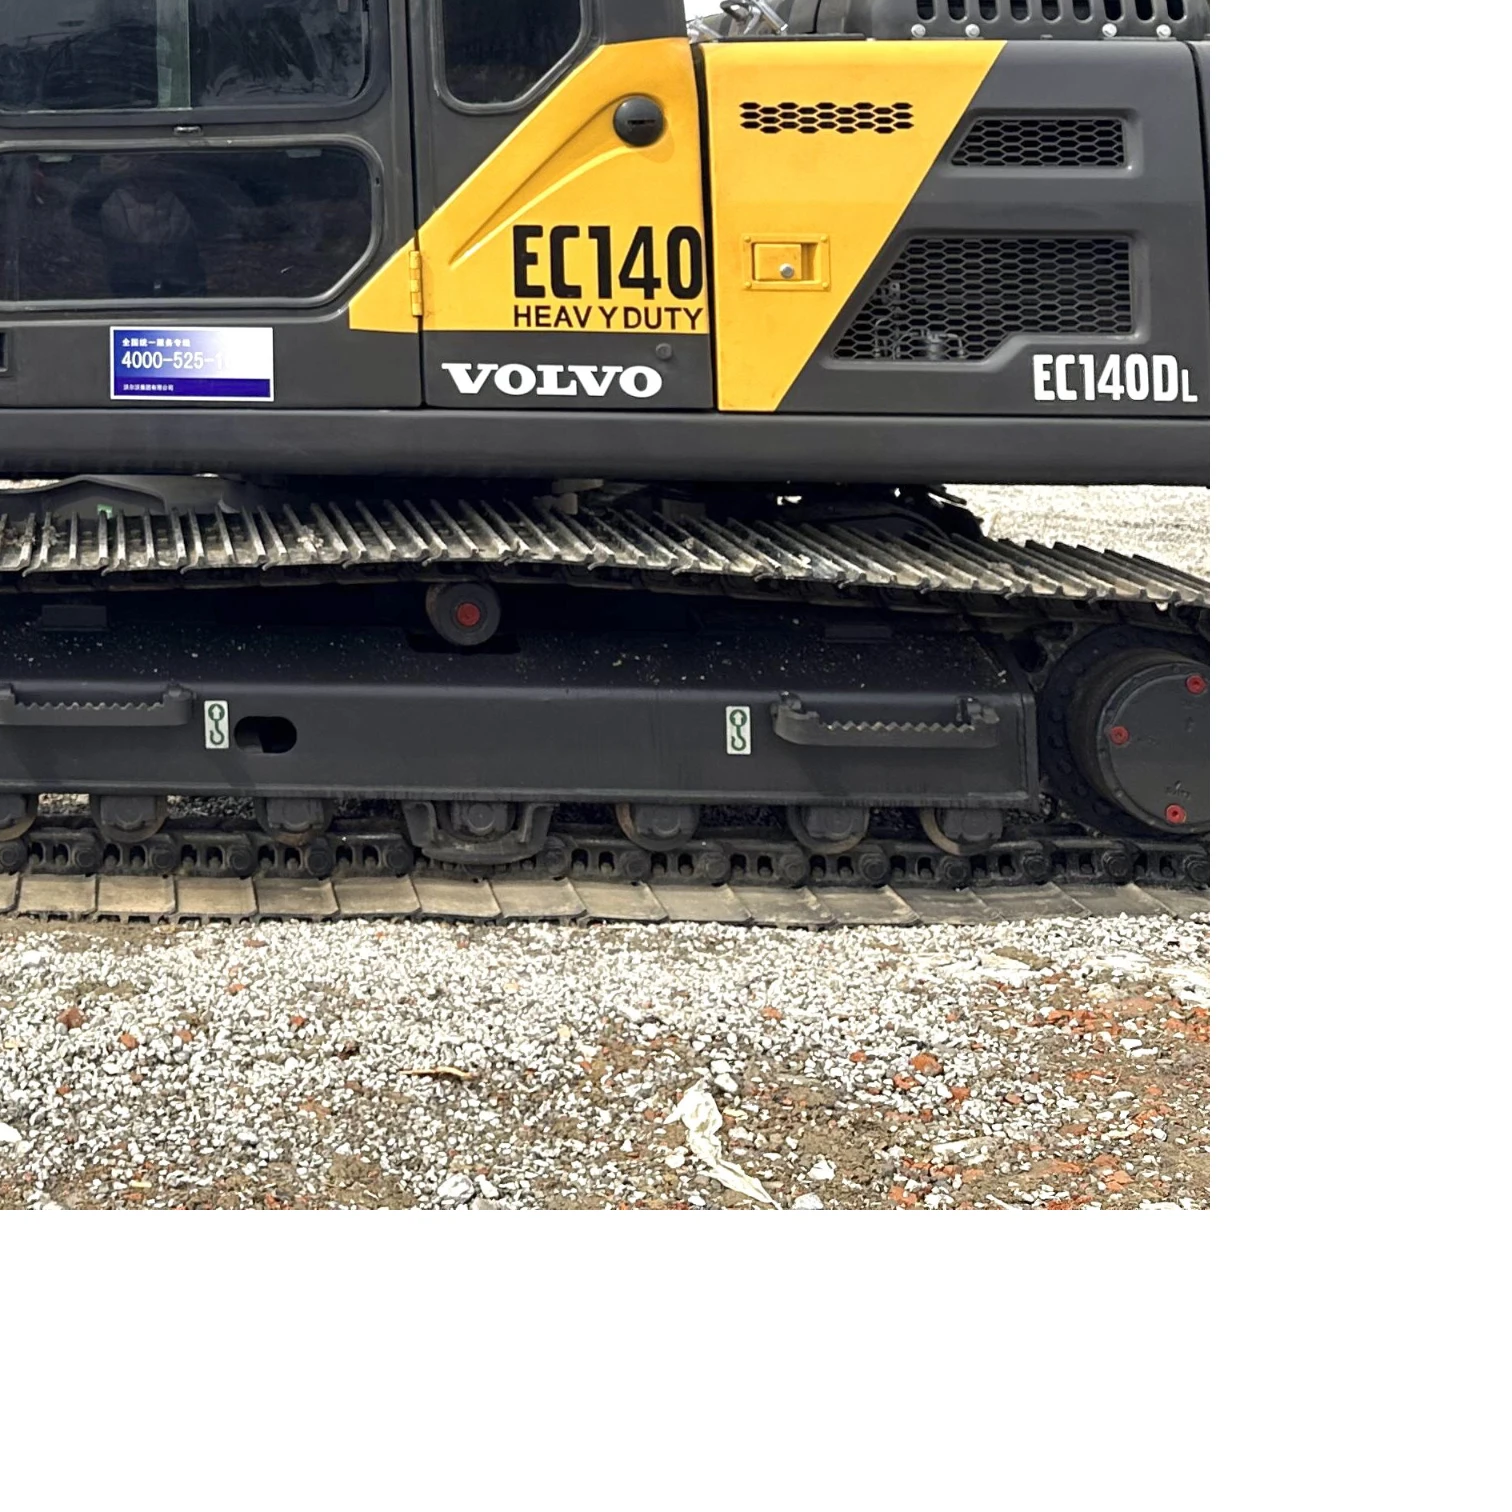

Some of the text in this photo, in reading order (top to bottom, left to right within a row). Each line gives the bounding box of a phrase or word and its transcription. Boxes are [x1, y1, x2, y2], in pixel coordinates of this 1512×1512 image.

[513, 225, 703, 300] EC140
[441, 362, 663, 398] VOLVO
[1033, 353, 1199, 403] EC140DL
